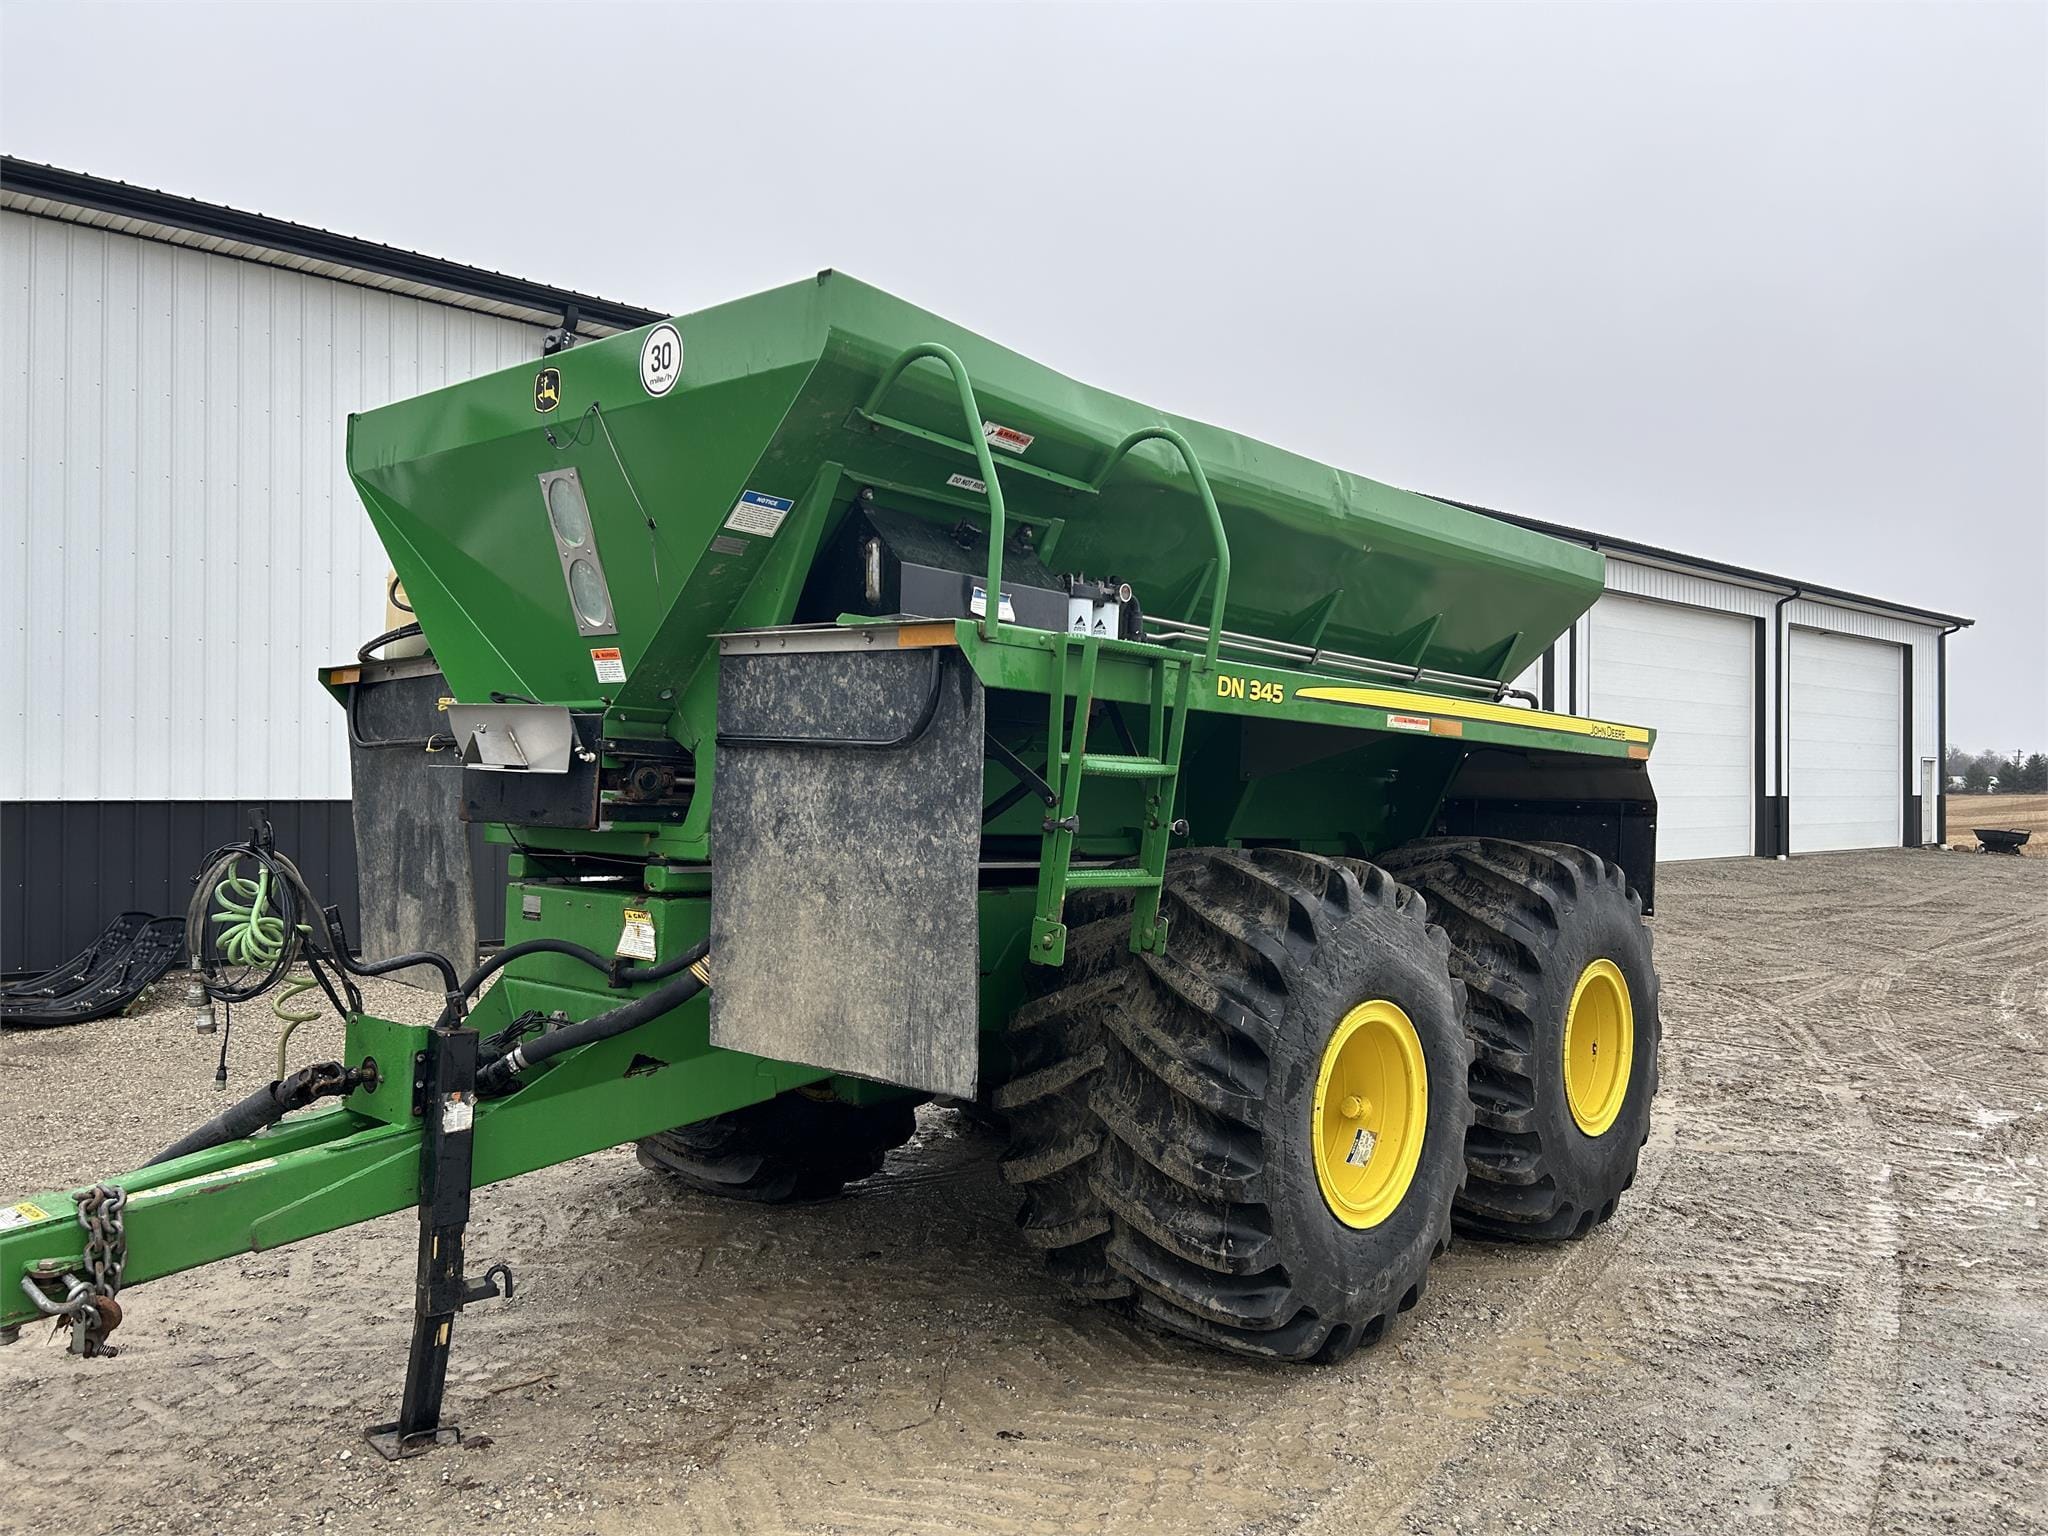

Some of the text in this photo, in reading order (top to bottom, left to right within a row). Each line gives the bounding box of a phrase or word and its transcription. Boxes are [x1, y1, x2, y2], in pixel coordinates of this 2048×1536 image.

[651, 341, 671, 372] 30
[650, 373, 672, 385] mile/h
[952, 476, 961, 484] DO
[961, 479, 973, 488] NOT
[757, 496, 778, 507] NOTICE
[1217, 674, 1284, 704] DN 345
[1591, 723, 1626, 740] JOHN DEERE
